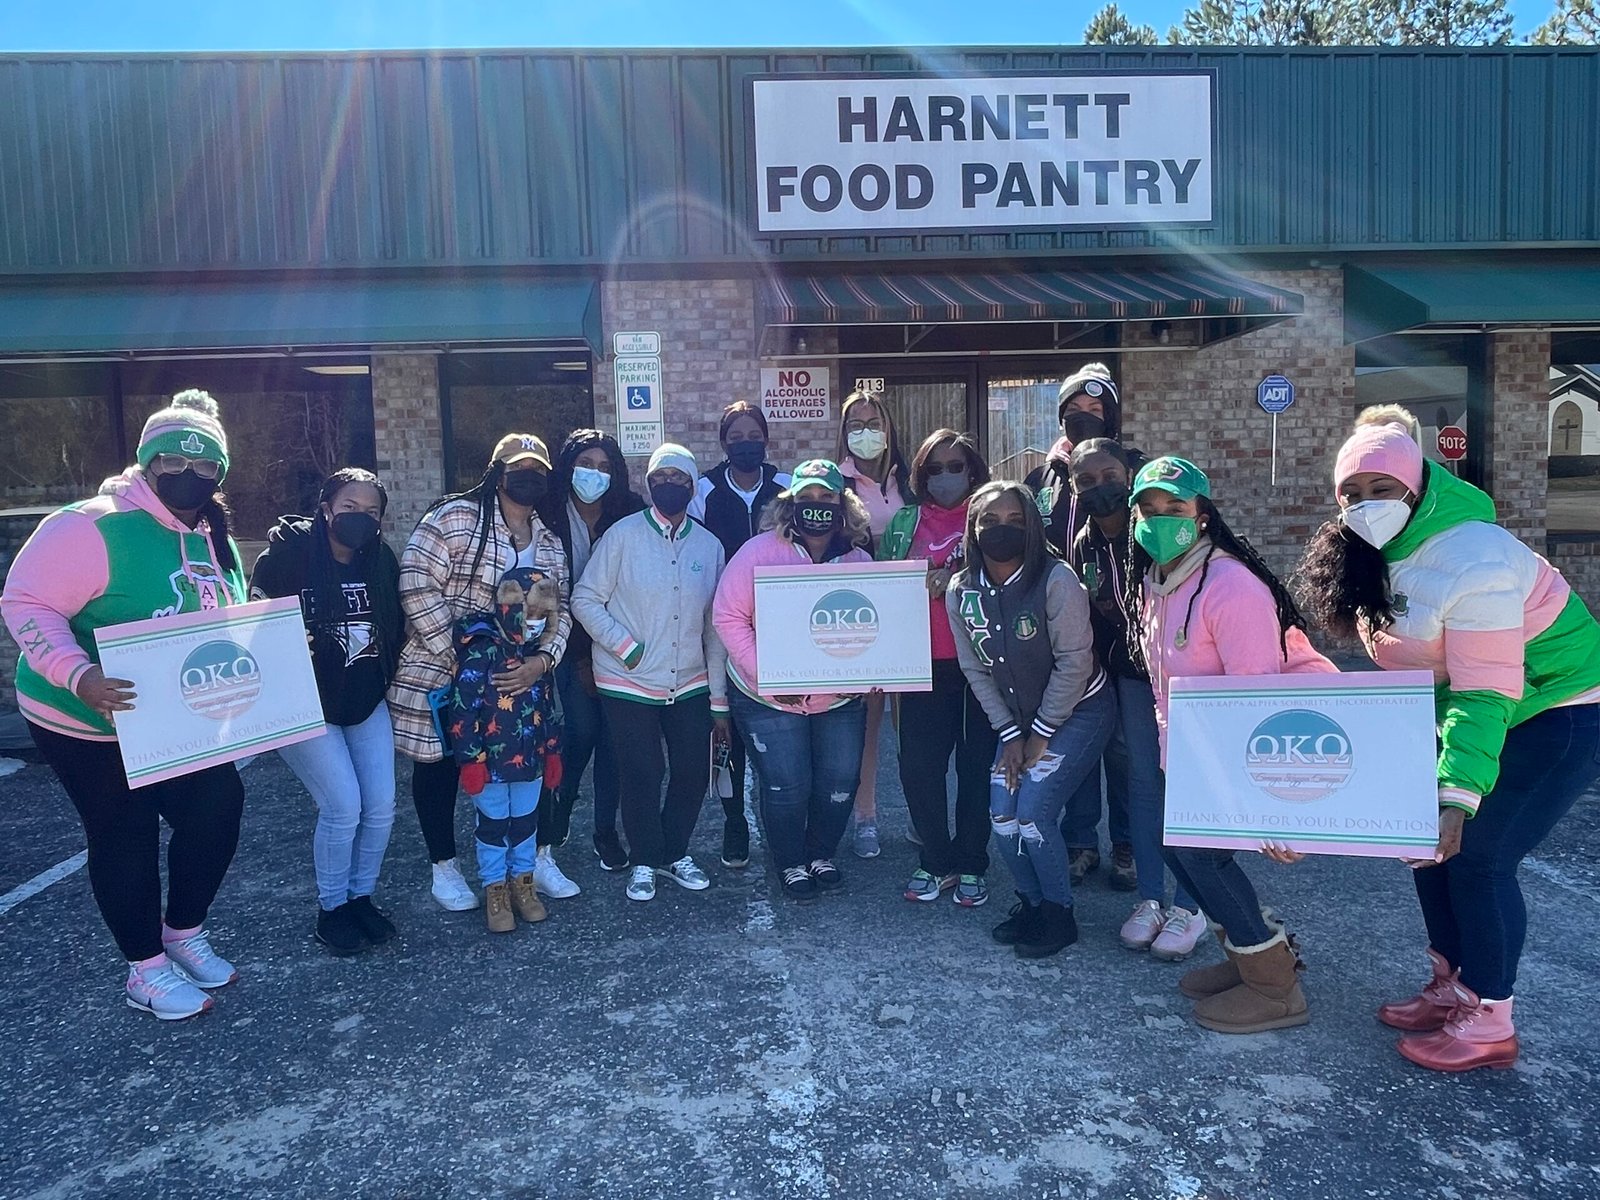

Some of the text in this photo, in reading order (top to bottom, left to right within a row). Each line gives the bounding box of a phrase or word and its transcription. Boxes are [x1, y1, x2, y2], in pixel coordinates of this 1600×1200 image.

[837, 92, 1131, 143] HARNETT
[765, 158, 1202, 213] FOOD PANTRY
[622, 343, 652, 351] ACCESSIBLE
[618, 362, 657, 372] RESERVED
[620, 374, 656, 383] PARKING
[778, 371, 811, 387] NO
[857, 379, 883, 391] 413
[765, 388, 826, 397] ALCOHOLIC
[1263, 387, 1288, 401] ADT
[765, 398, 826, 408] BEVERAGES
[769, 409, 824, 418] ALLOWED
[633, 441, 651, 450] $250
[761, 669, 797, 679] THANK
[799, 668, 819, 678] YOU
[822, 668, 842, 677] FOR
[875, 665, 929, 675] DONATION
[1335, 697, 1418, 706] INCORPORATED
[129, 747, 175, 766] THANK
[176, 740, 202, 753] YOU
[230, 726, 264, 740] YOUR
[265, 710, 320, 729] DONATION
[1173, 812, 1436, 831] THANK YOU FOR YOUR DONATION
